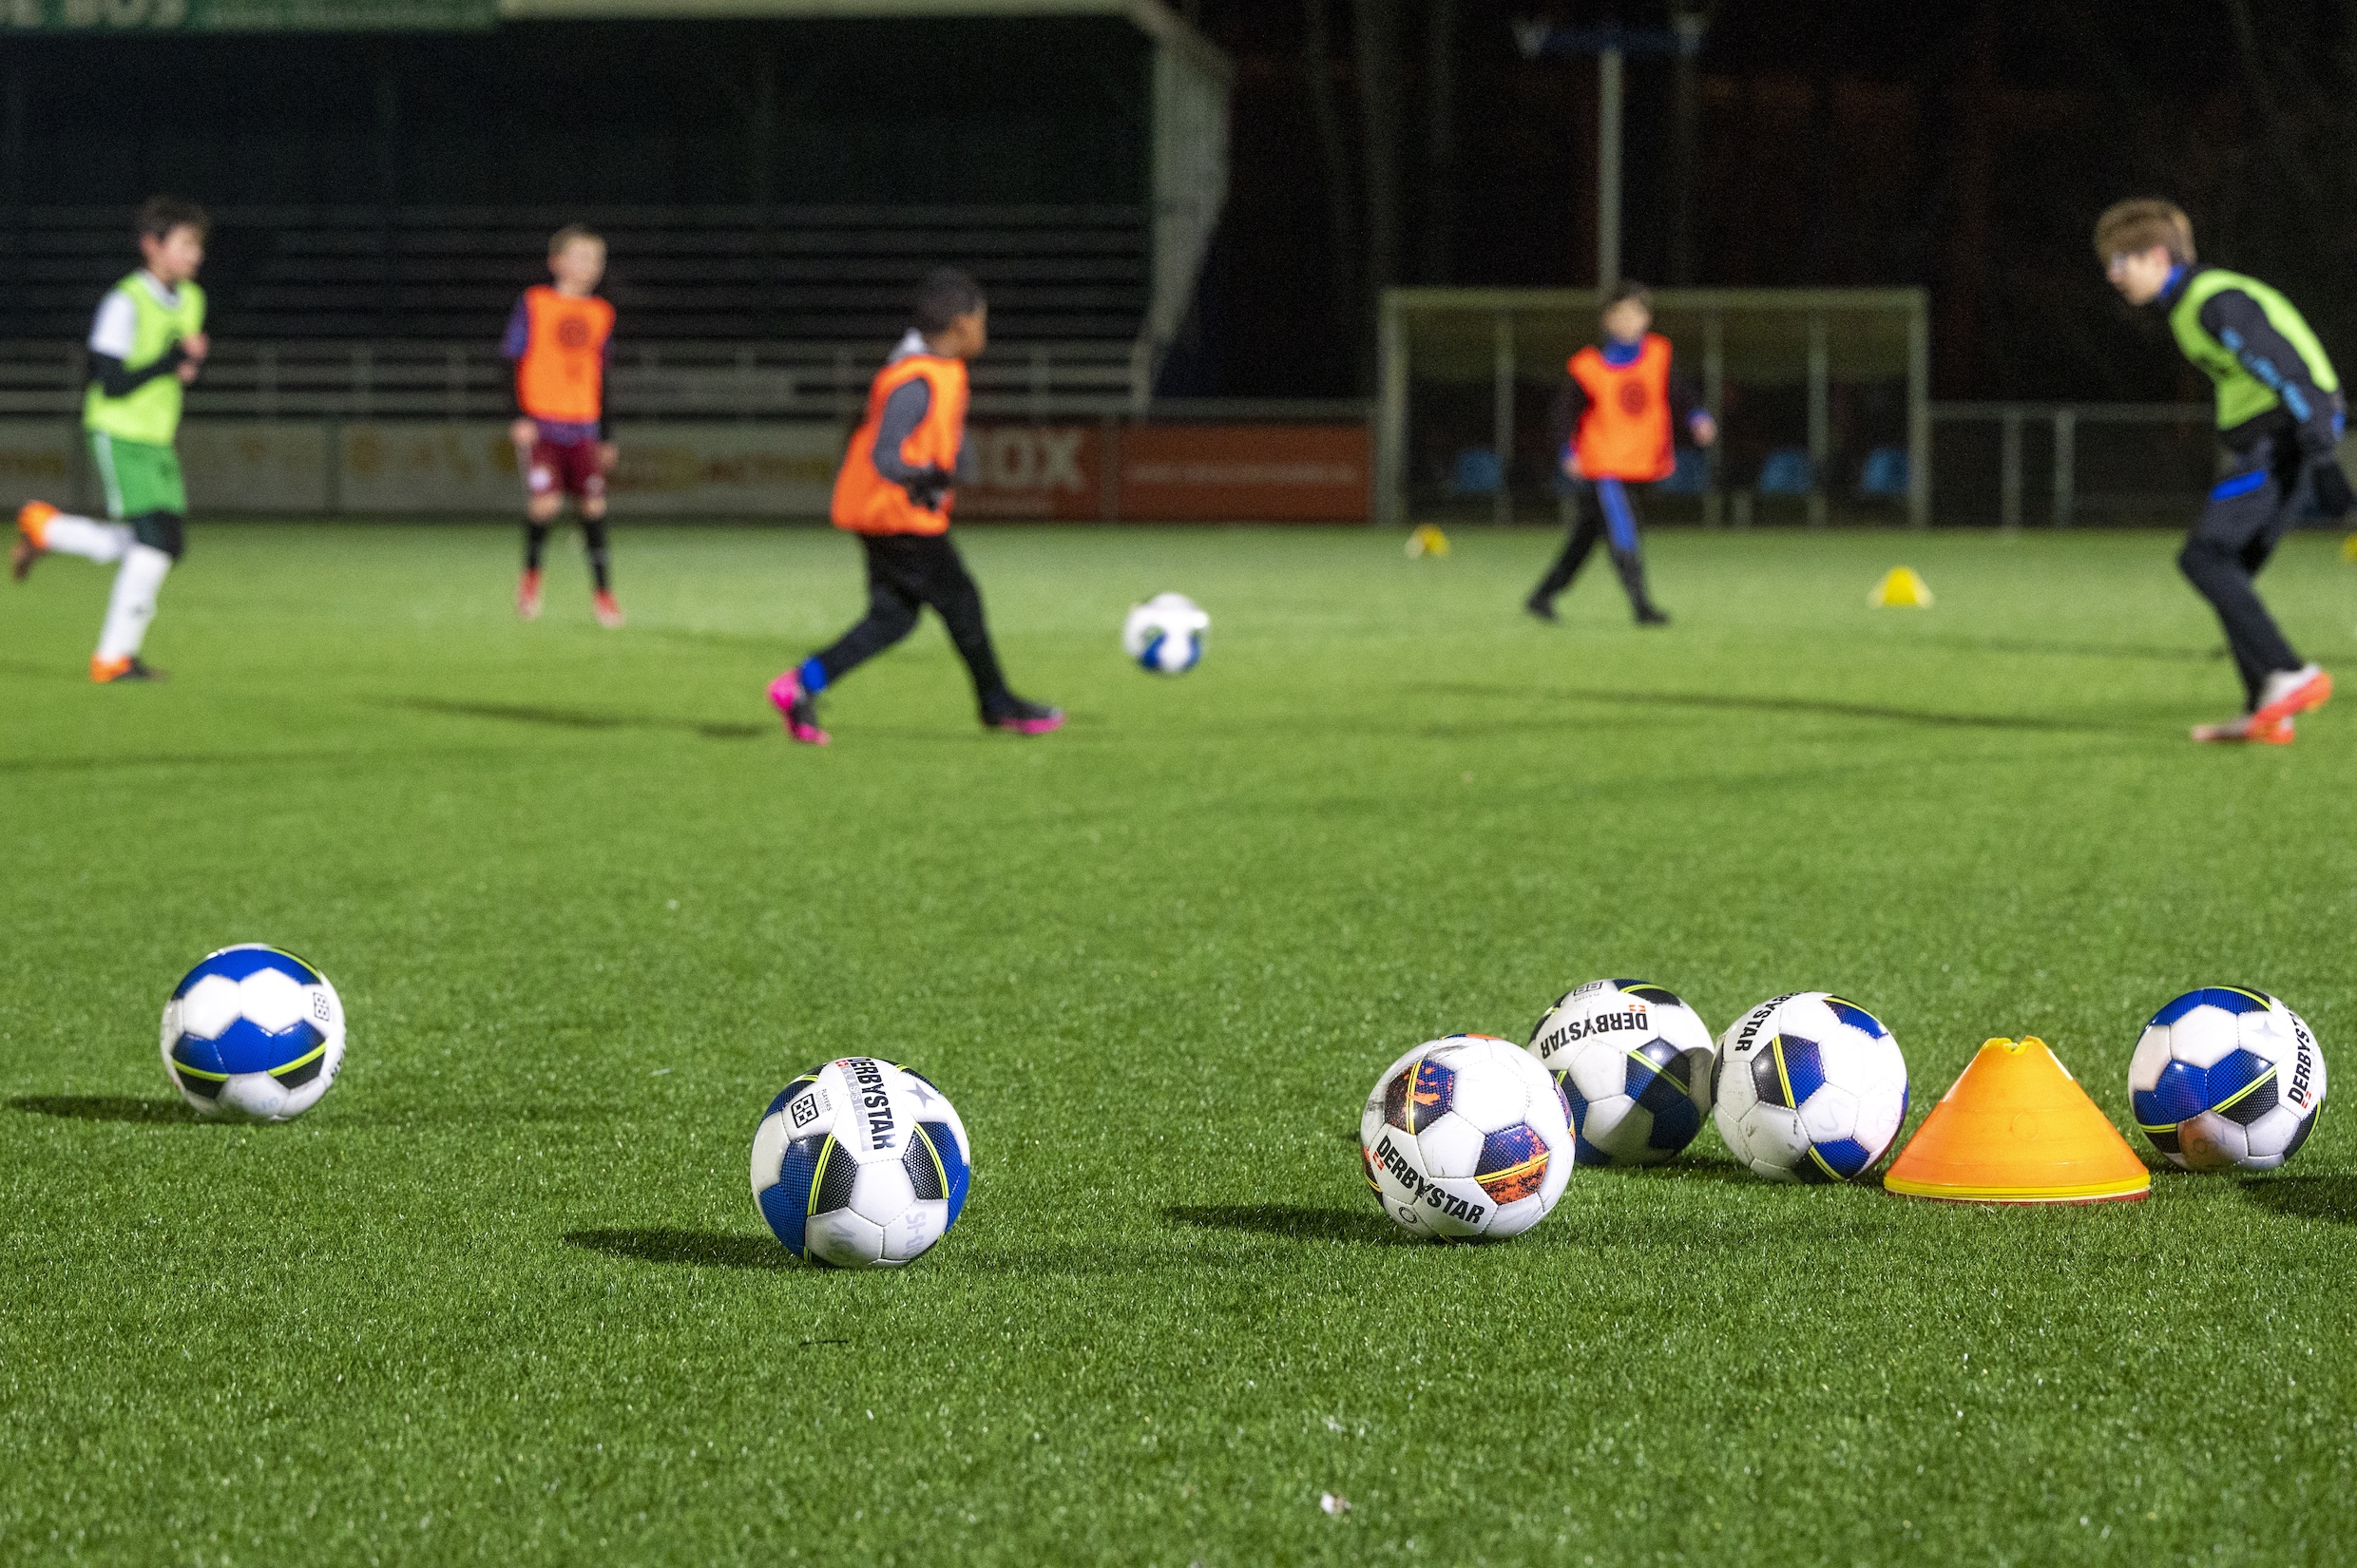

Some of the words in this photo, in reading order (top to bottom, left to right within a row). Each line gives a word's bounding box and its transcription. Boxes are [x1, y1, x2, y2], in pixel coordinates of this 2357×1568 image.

[1540, 1012, 1649, 1060] DERBYSTAR
[2283, 1005, 2311, 1104] DERBYST
[821, 1088, 833, 1112] PLAYERS
[842, 1066, 866, 1116] CLASSIC
[1376, 1135, 1485, 1224] DERBYSTAR
